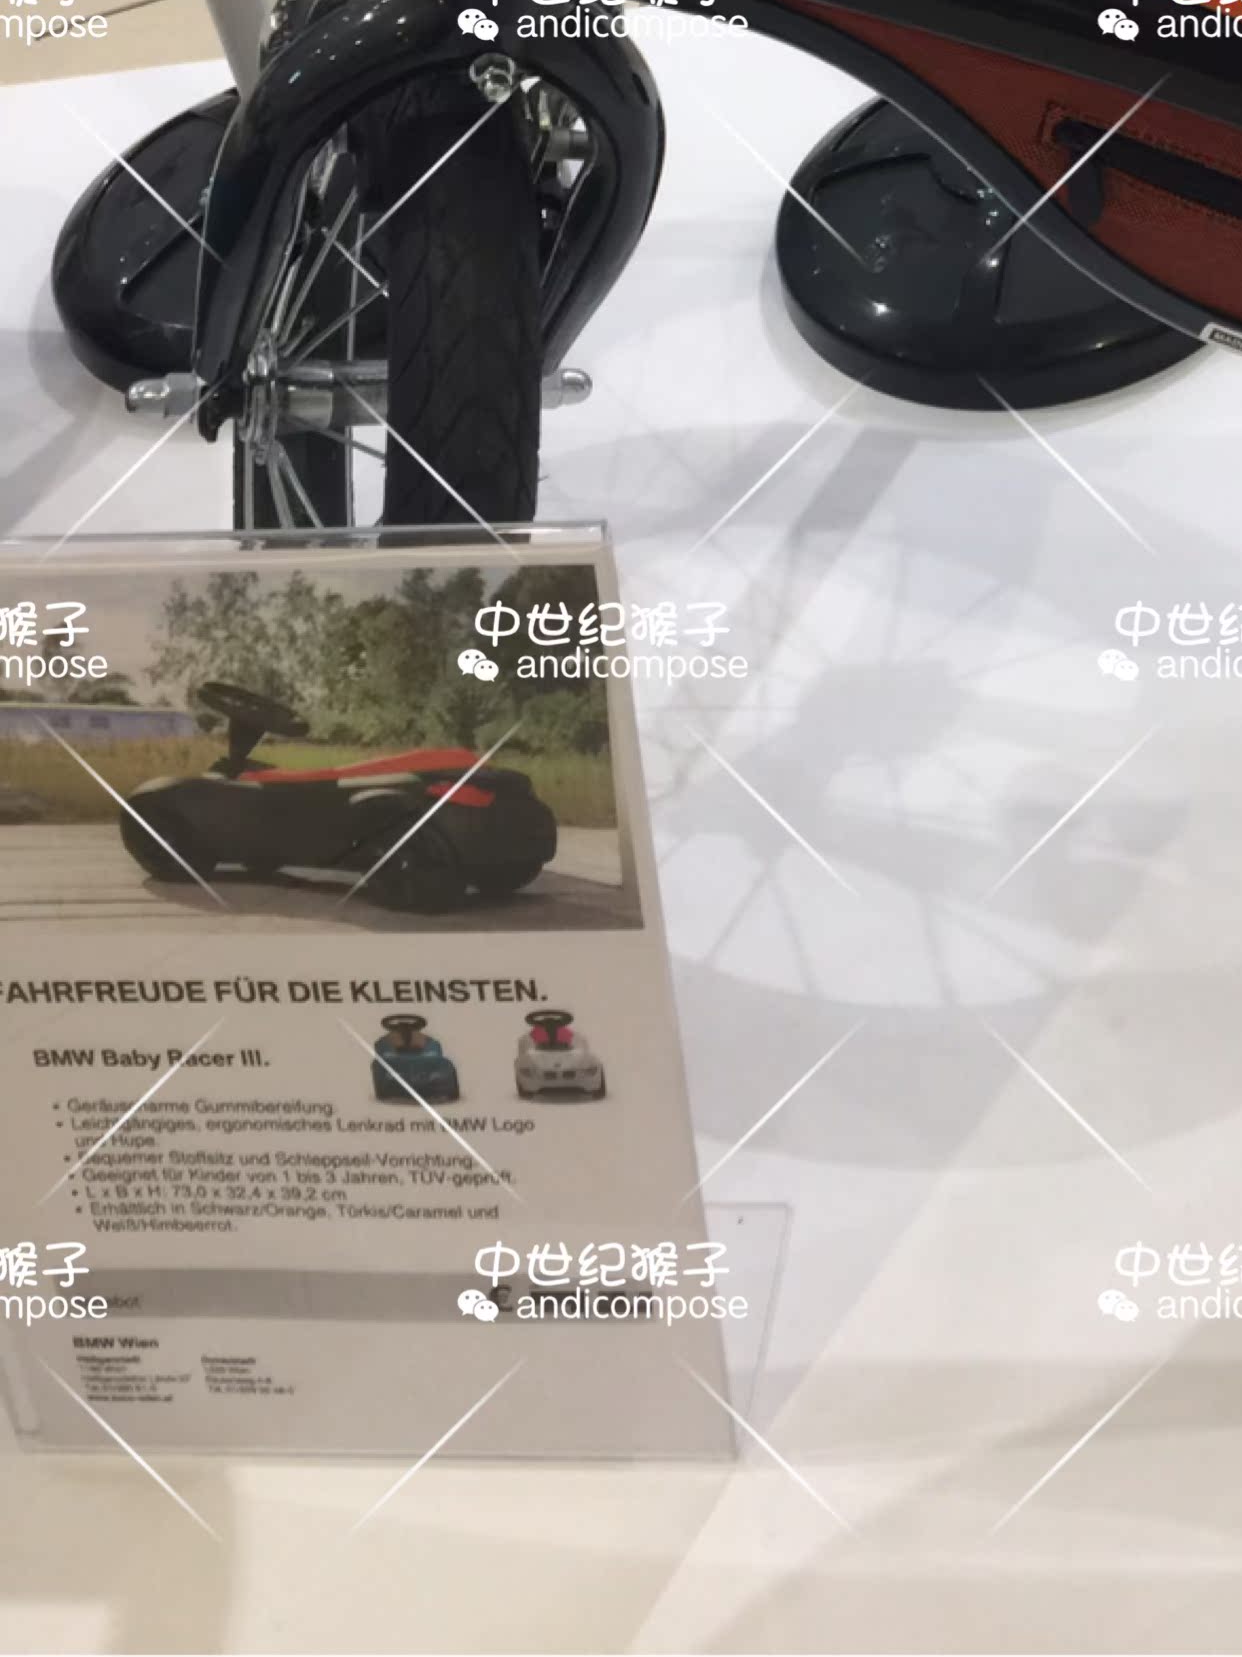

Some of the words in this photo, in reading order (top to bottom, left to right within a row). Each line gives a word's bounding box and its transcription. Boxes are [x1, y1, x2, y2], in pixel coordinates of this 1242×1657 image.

[0, 979, 208, 1004] AHRFREUDE
[213, 975, 280, 1004] FÜR
[288, 979, 344, 1003] DIE
[349, 978, 549, 1004] KLEINSTEN.
[33, 1048, 94, 1067] BMW
[101, 1048, 161, 1071] Baby
[166, 1048, 235, 1067] Racer
[241, 1048, 270, 1067] III.
[206, 1118, 332, 1134] ergonomisches
[337, 1118, 405, 1133] Lenkrad
[410, 1118, 436, 1132] mit
[492, 1116, 535, 1135] Logo
[239, 1152, 270, 1167] und
[188, 1168, 240, 1183] Kinder
[248, 1171, 276, 1183] von
[296, 1169, 321, 1185] bis
[326, 1170, 336, 1185] 3
[468, 1205, 500, 1220] und
